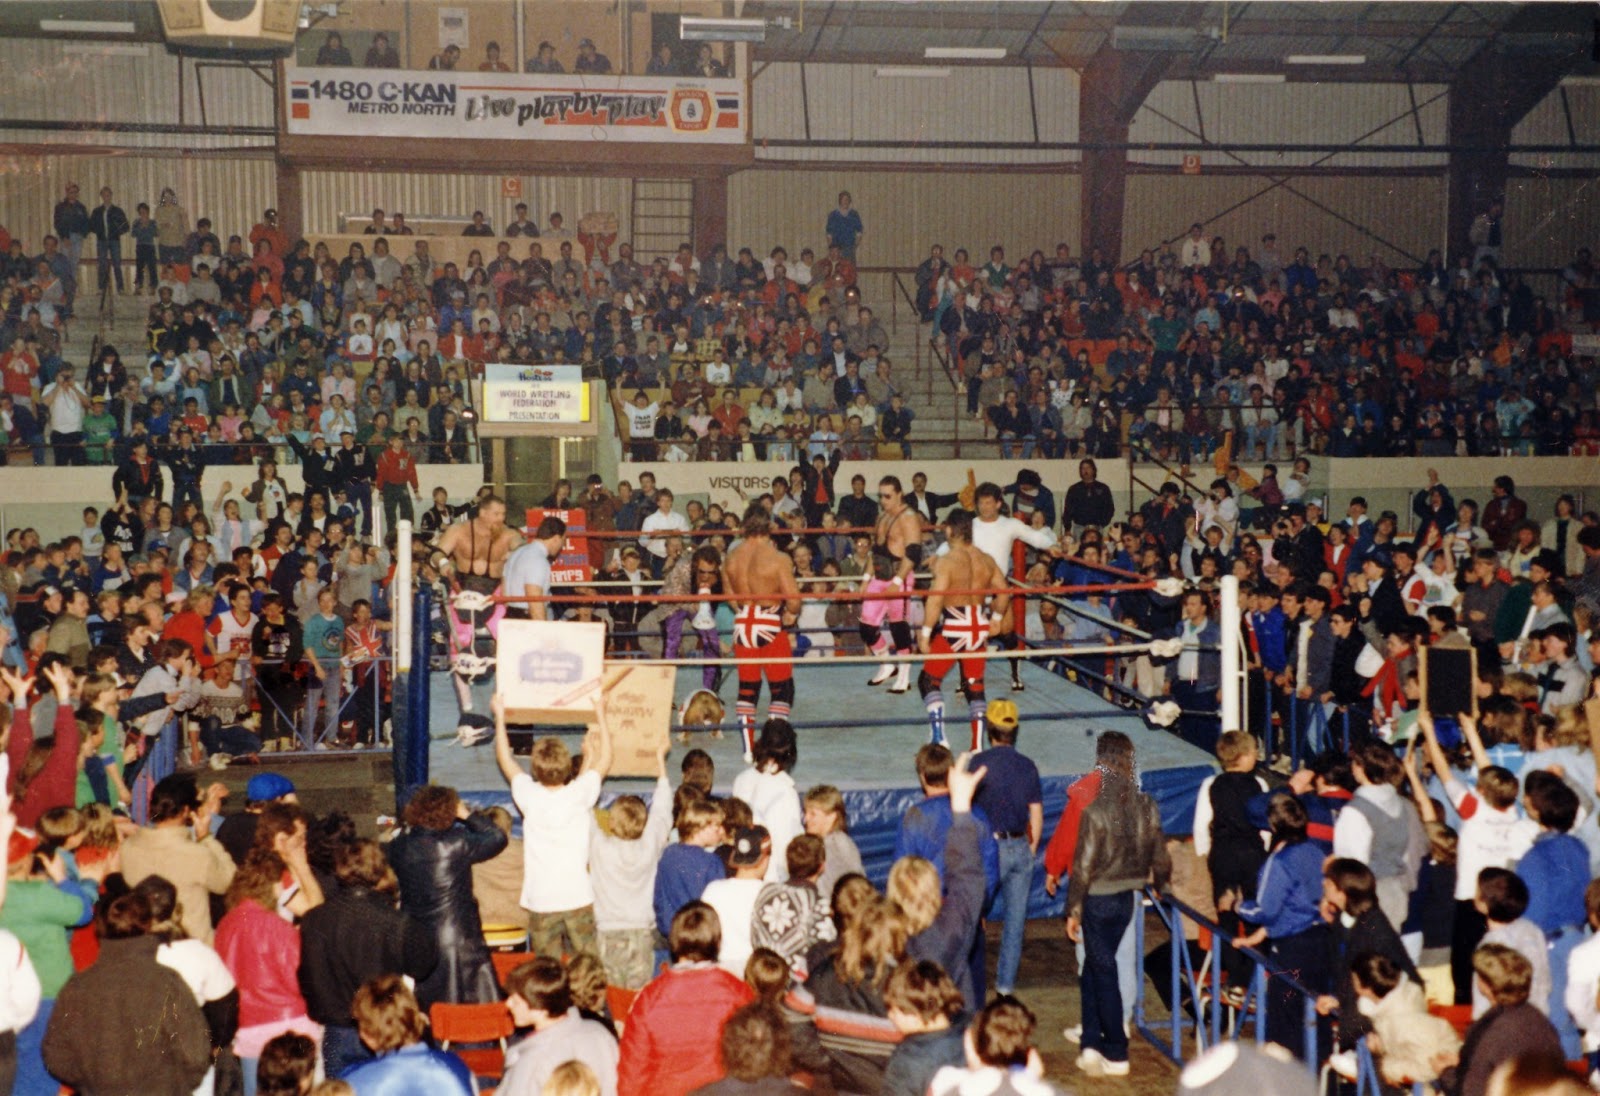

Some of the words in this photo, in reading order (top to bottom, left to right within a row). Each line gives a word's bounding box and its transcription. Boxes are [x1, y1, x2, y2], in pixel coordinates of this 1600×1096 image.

[310, 80, 373, 101] 1480
[347, 101, 398, 114] METRO
[401, 103, 455, 116] NORTH
[464, 95, 516, 121] Live
[506, 177, 518, 191] C
[500, 390, 527, 398] WORLD
[513, 399, 557, 408] FEDERATION
[509, 411, 560, 420] PRESENTATION
[709, 476, 770, 489] VISITORS
